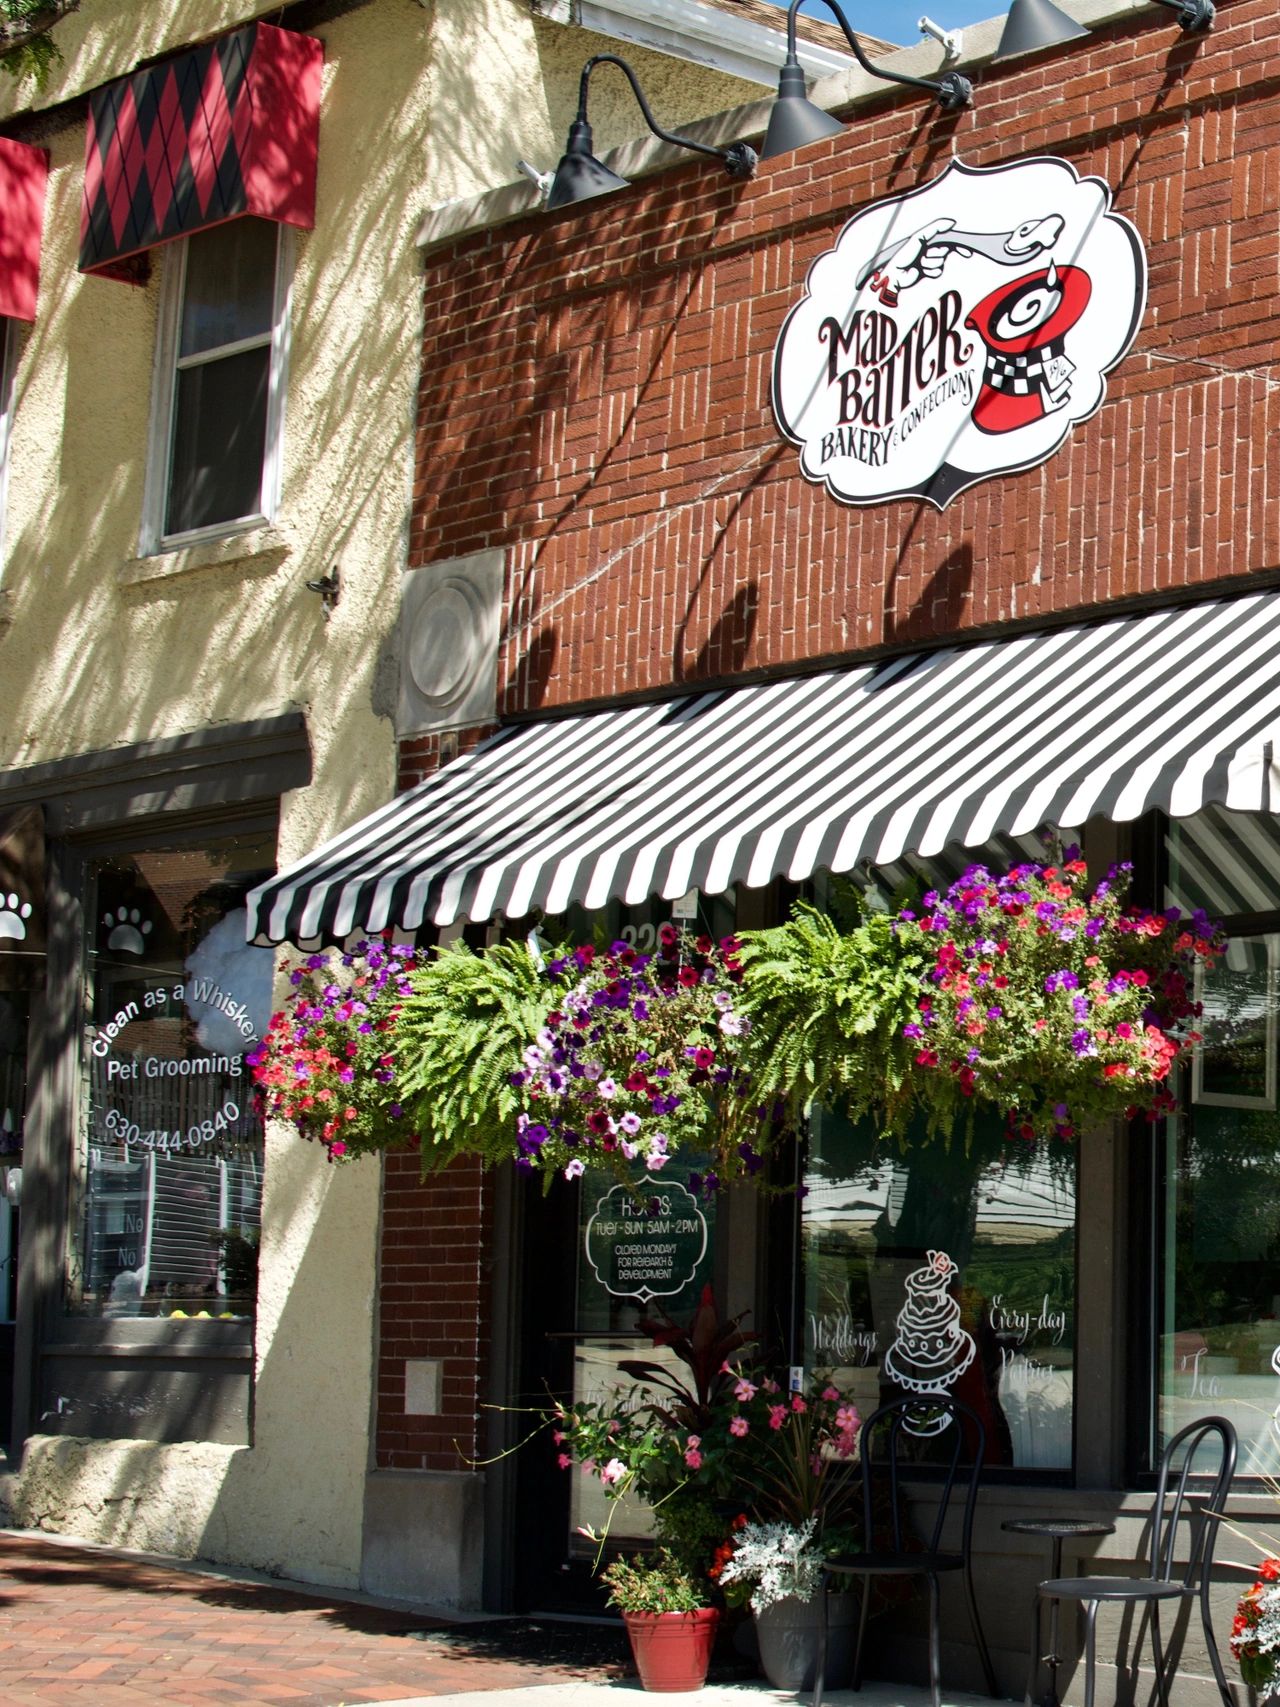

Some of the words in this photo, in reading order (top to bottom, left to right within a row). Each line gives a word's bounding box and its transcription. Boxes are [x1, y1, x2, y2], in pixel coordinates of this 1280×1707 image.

[820, 425, 894, 466] BAKERY
[899, 368, 976, 442] CONFECTIONS
[92, 1000, 139, 1058] Clean
[143, 986, 166, 1009] as
[173, 984, 184, 1001] a
[193, 979, 260, 1045] Whisker
[107, 1060, 138, 1081] Pet
[145, 1052, 243, 1080] Grooming
[105, 1101, 240, 1151] 630-444-0840
[618, 1257, 631, 1268] FOR
[618, 1269, 672, 1280] DEVELOPMENT
[809, 1315, 879, 1367] Weddings
[999, 1348, 1057, 1385] Pastries
[1181, 1347, 1223, 1399] Tea
